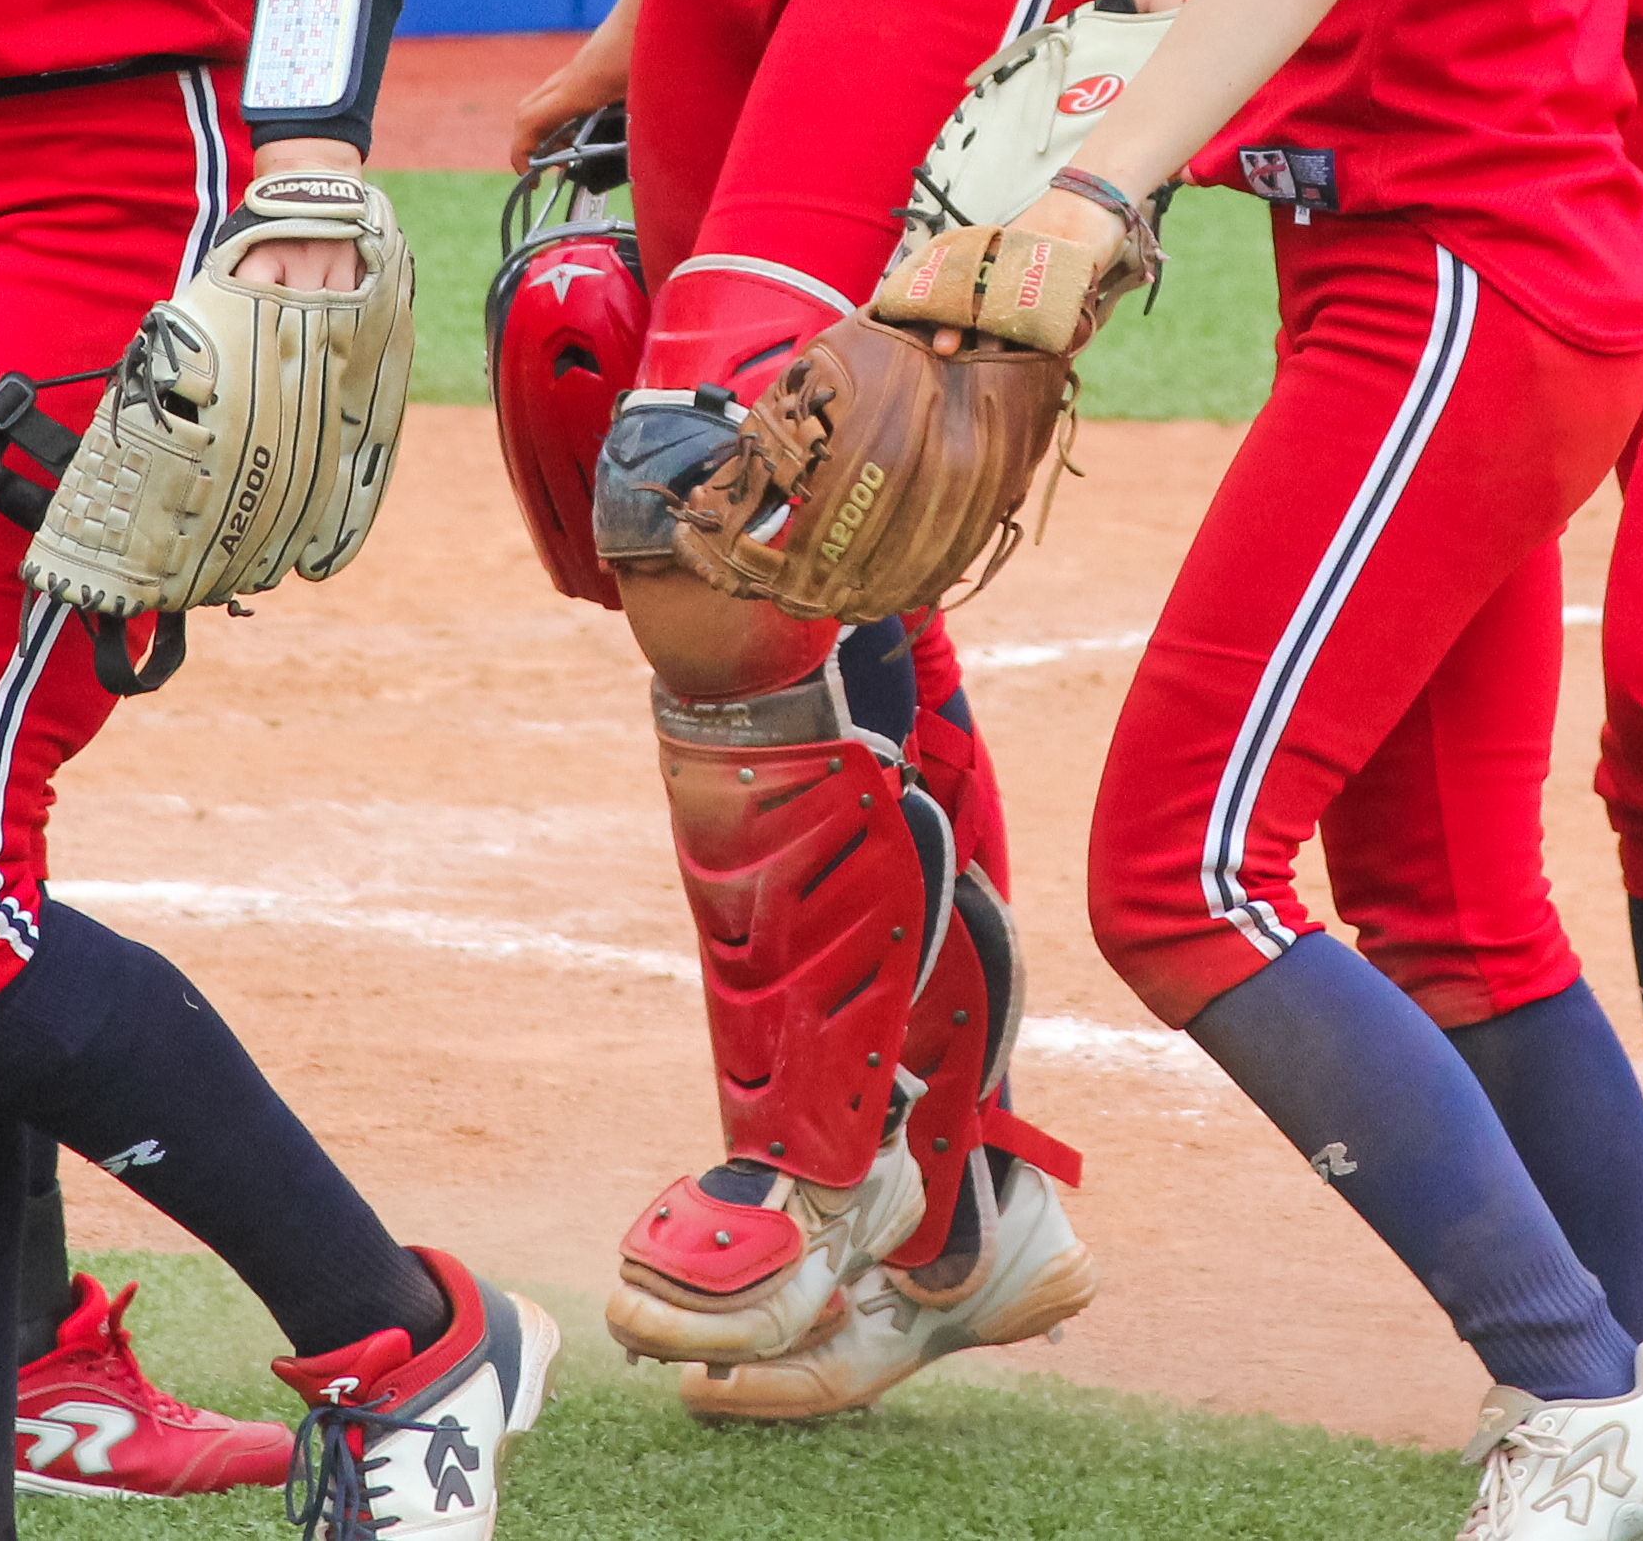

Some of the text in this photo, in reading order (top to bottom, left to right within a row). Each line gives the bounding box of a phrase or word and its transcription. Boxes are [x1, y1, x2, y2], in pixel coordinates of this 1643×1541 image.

[262, 181, 360, 200] Wilson
[908, 245, 951, 300] Wilson
[1017, 242, 1052, 309] Wilson
[219, 445, 272, 557] A2000
[820, 461, 886, 564] A2000
